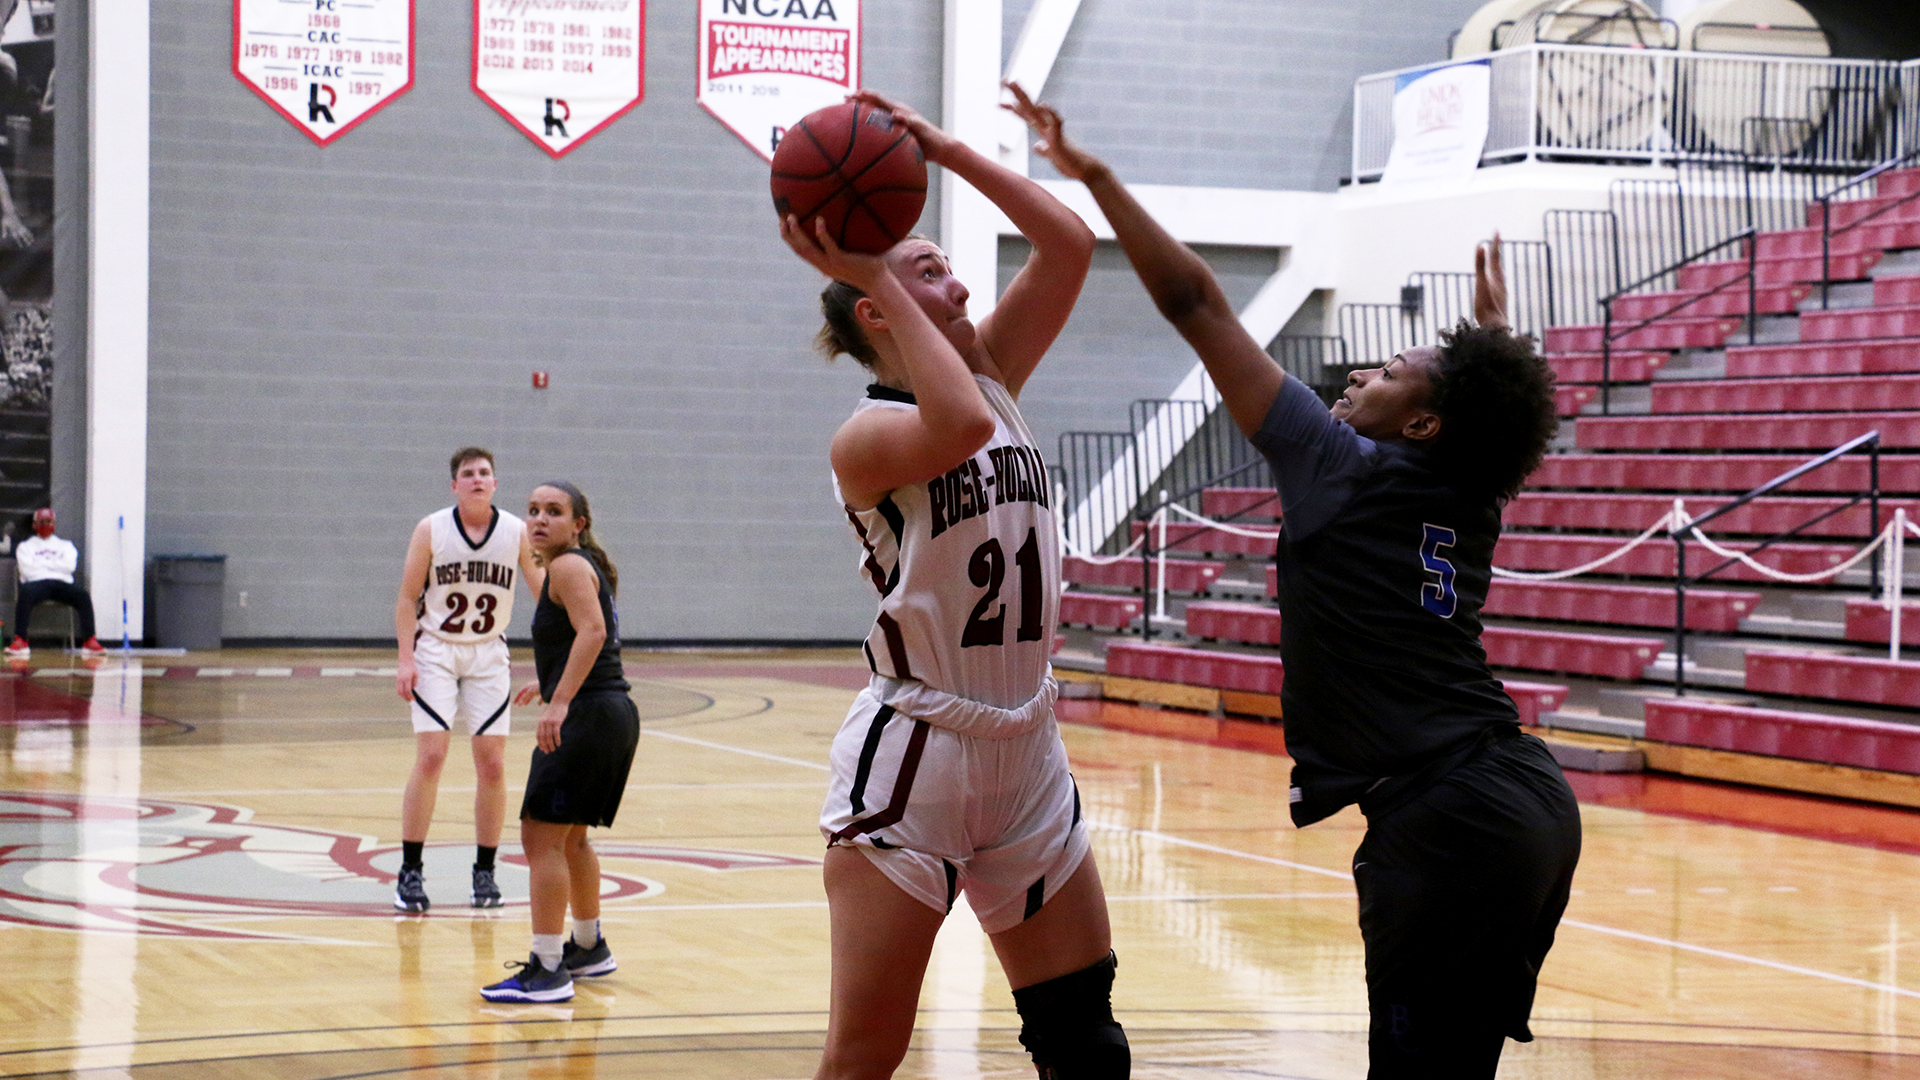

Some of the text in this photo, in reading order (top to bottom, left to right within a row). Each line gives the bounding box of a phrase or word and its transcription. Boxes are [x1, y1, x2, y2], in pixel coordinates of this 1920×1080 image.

[722, 0, 838, 21] NCAA
[245, 43, 278, 58] 1976
[287, 45, 320, 61] 1977
[307, 31, 341, 44] CAC
[711, 23, 848, 53] TOURNAMENT
[303, 64, 344, 78] ICAC
[713, 46, 846, 82] APPEARANCES
[1420, 522, 1457, 619] 5
[961, 526, 1044, 648] 21
[439, 592, 498, 635] 23
